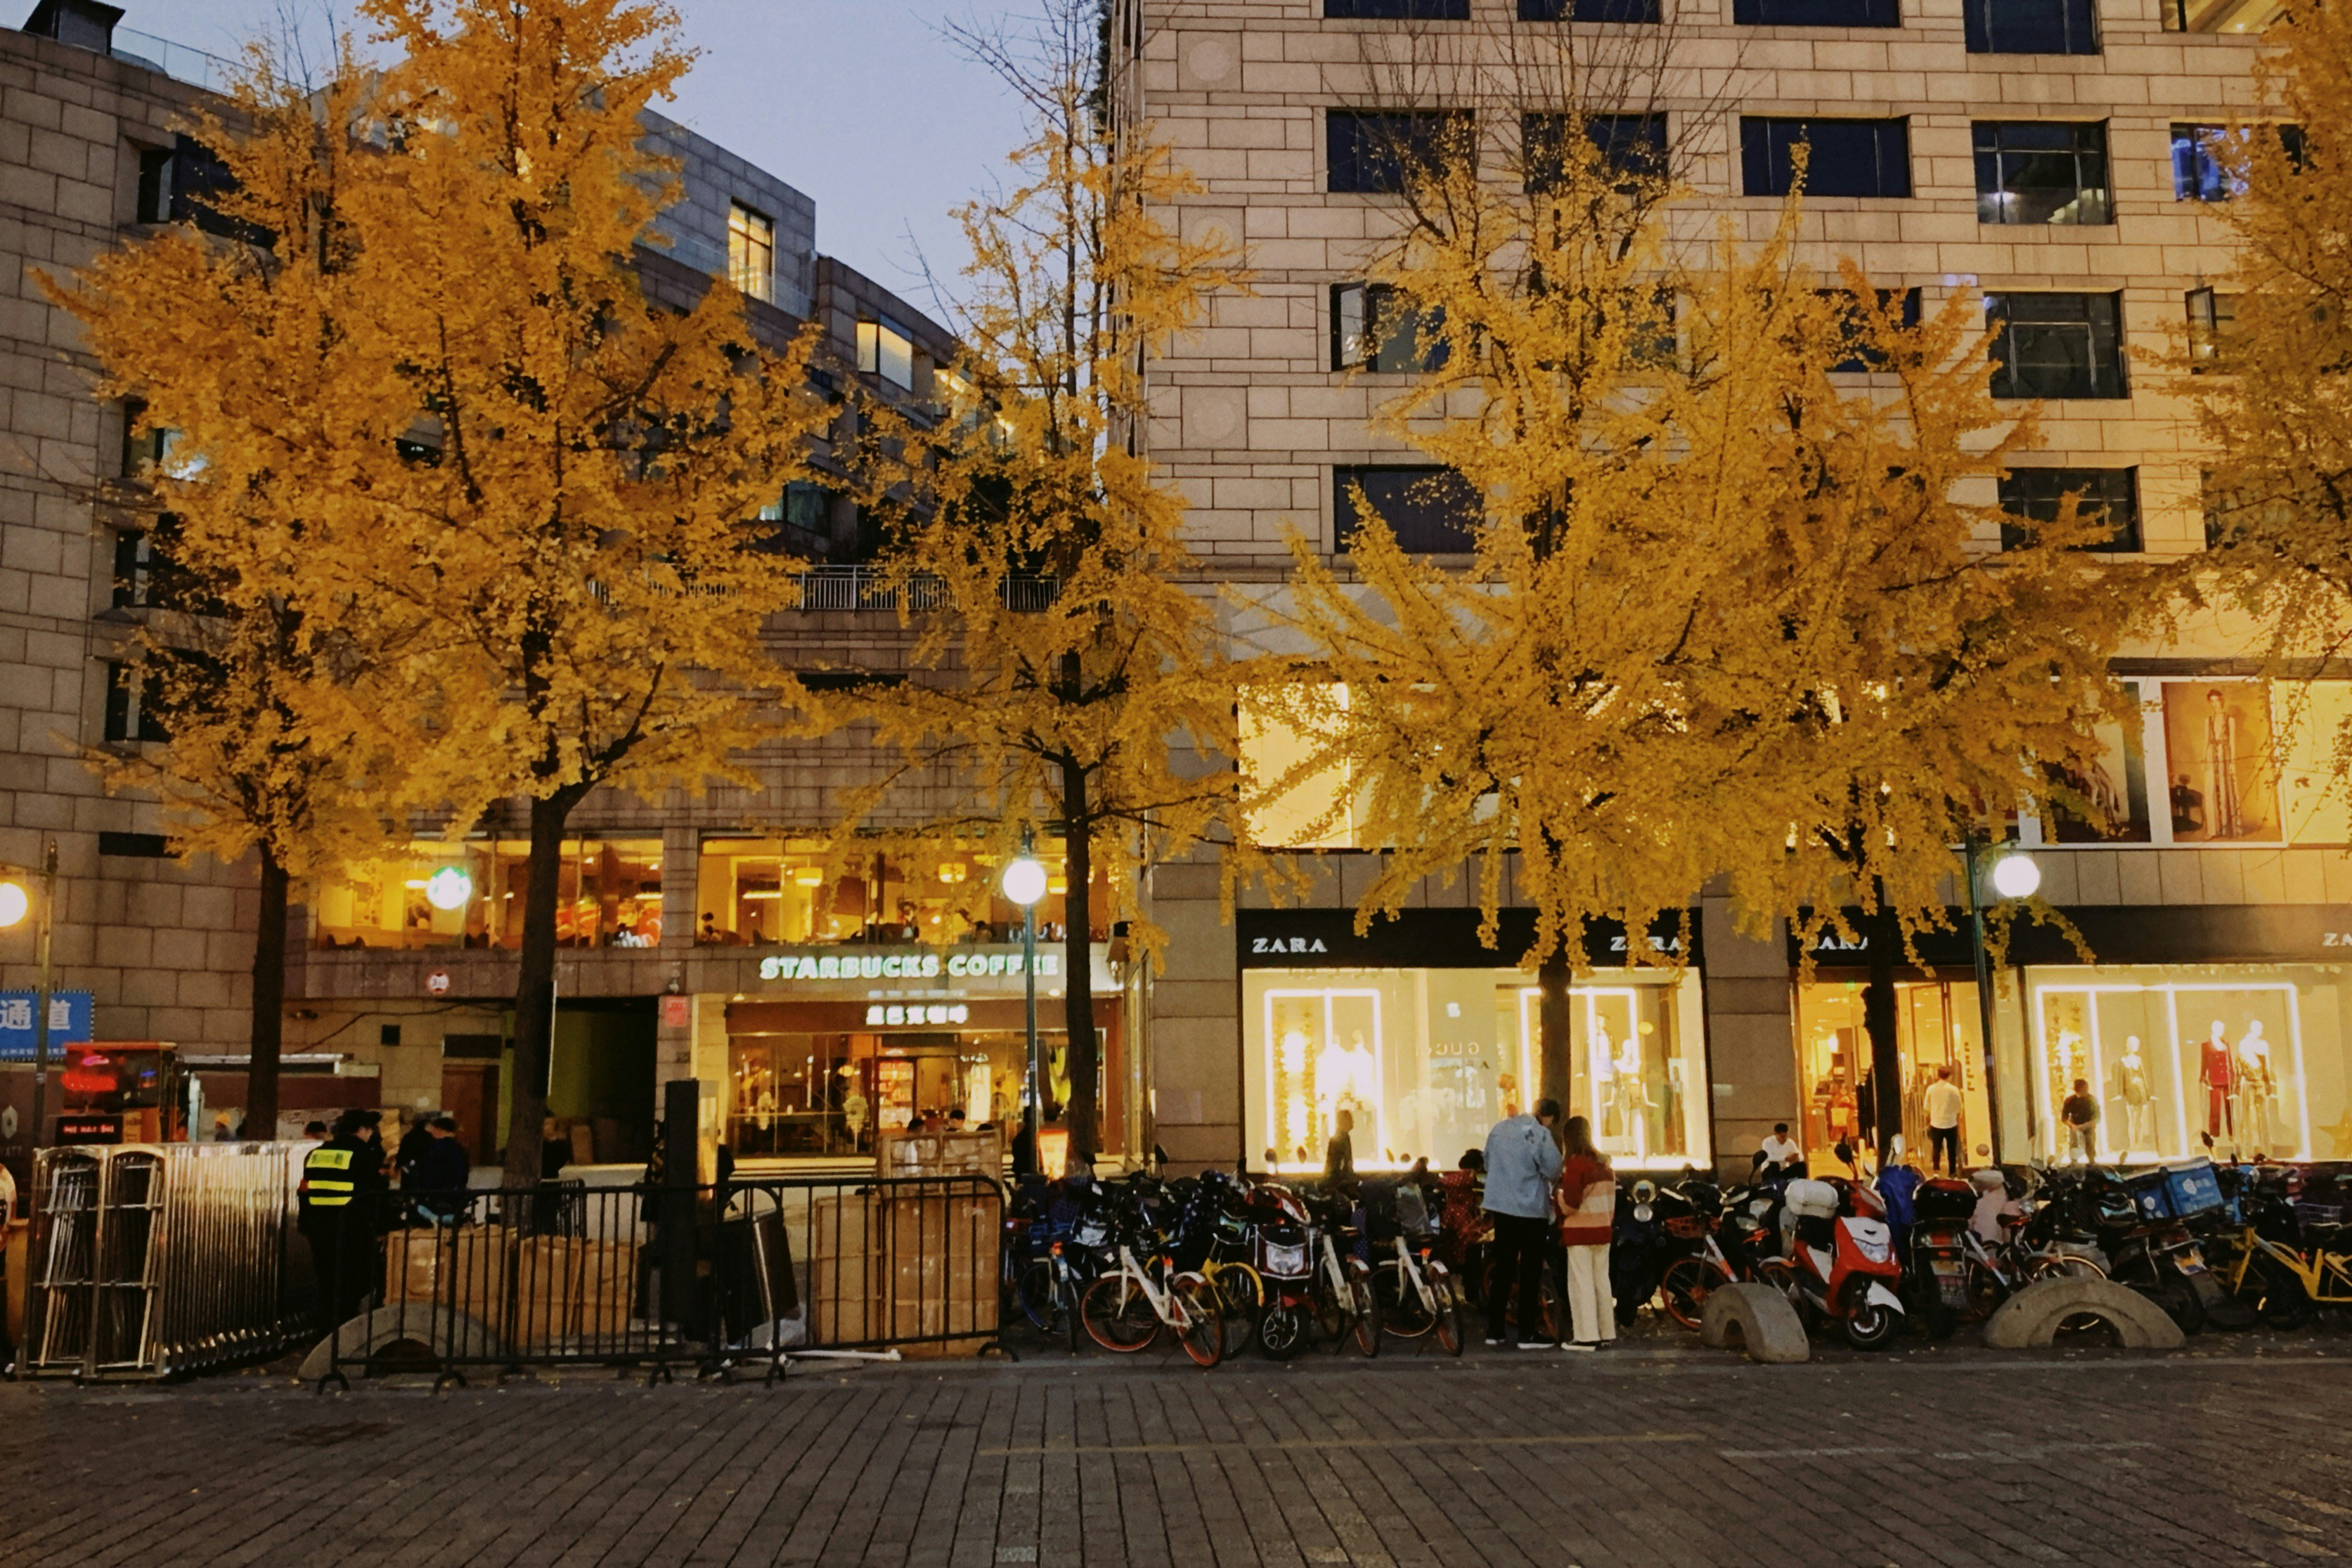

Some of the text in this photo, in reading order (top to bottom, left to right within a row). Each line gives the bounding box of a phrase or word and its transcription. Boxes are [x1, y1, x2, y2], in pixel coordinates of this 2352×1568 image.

[1253, 937, 1328, 953] ZARA
[1610, 936, 1684, 951] ZRA
[760, 954, 1059, 980] STARBUCKS COFFEE
